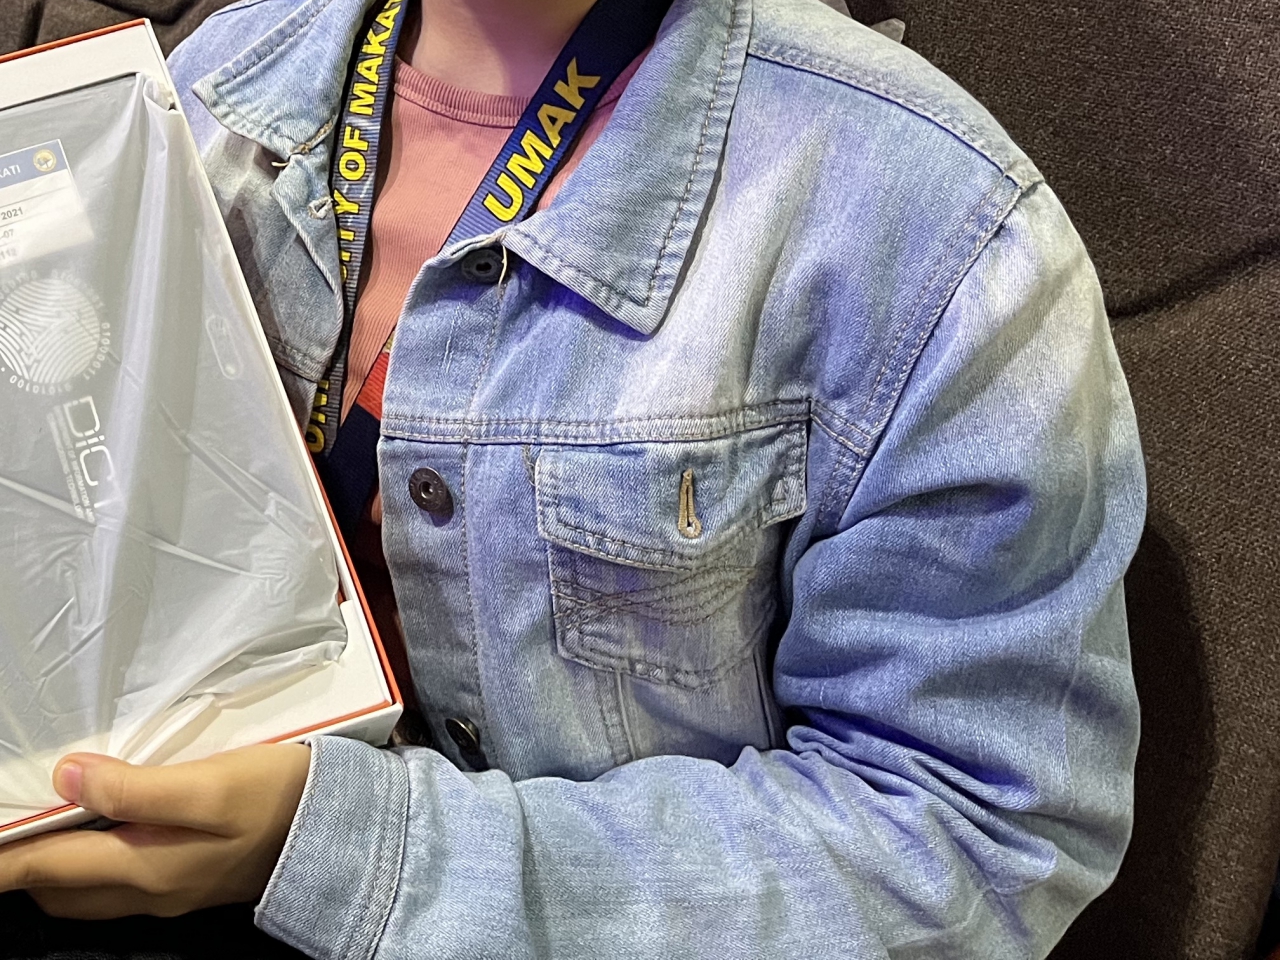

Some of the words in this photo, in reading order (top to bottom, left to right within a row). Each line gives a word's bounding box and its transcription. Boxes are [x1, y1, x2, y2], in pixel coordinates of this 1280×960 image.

[338, 126, 368, 181] OF
[483, 57, 601, 222] UMAK
[0, 206, 23, 221] 2021
